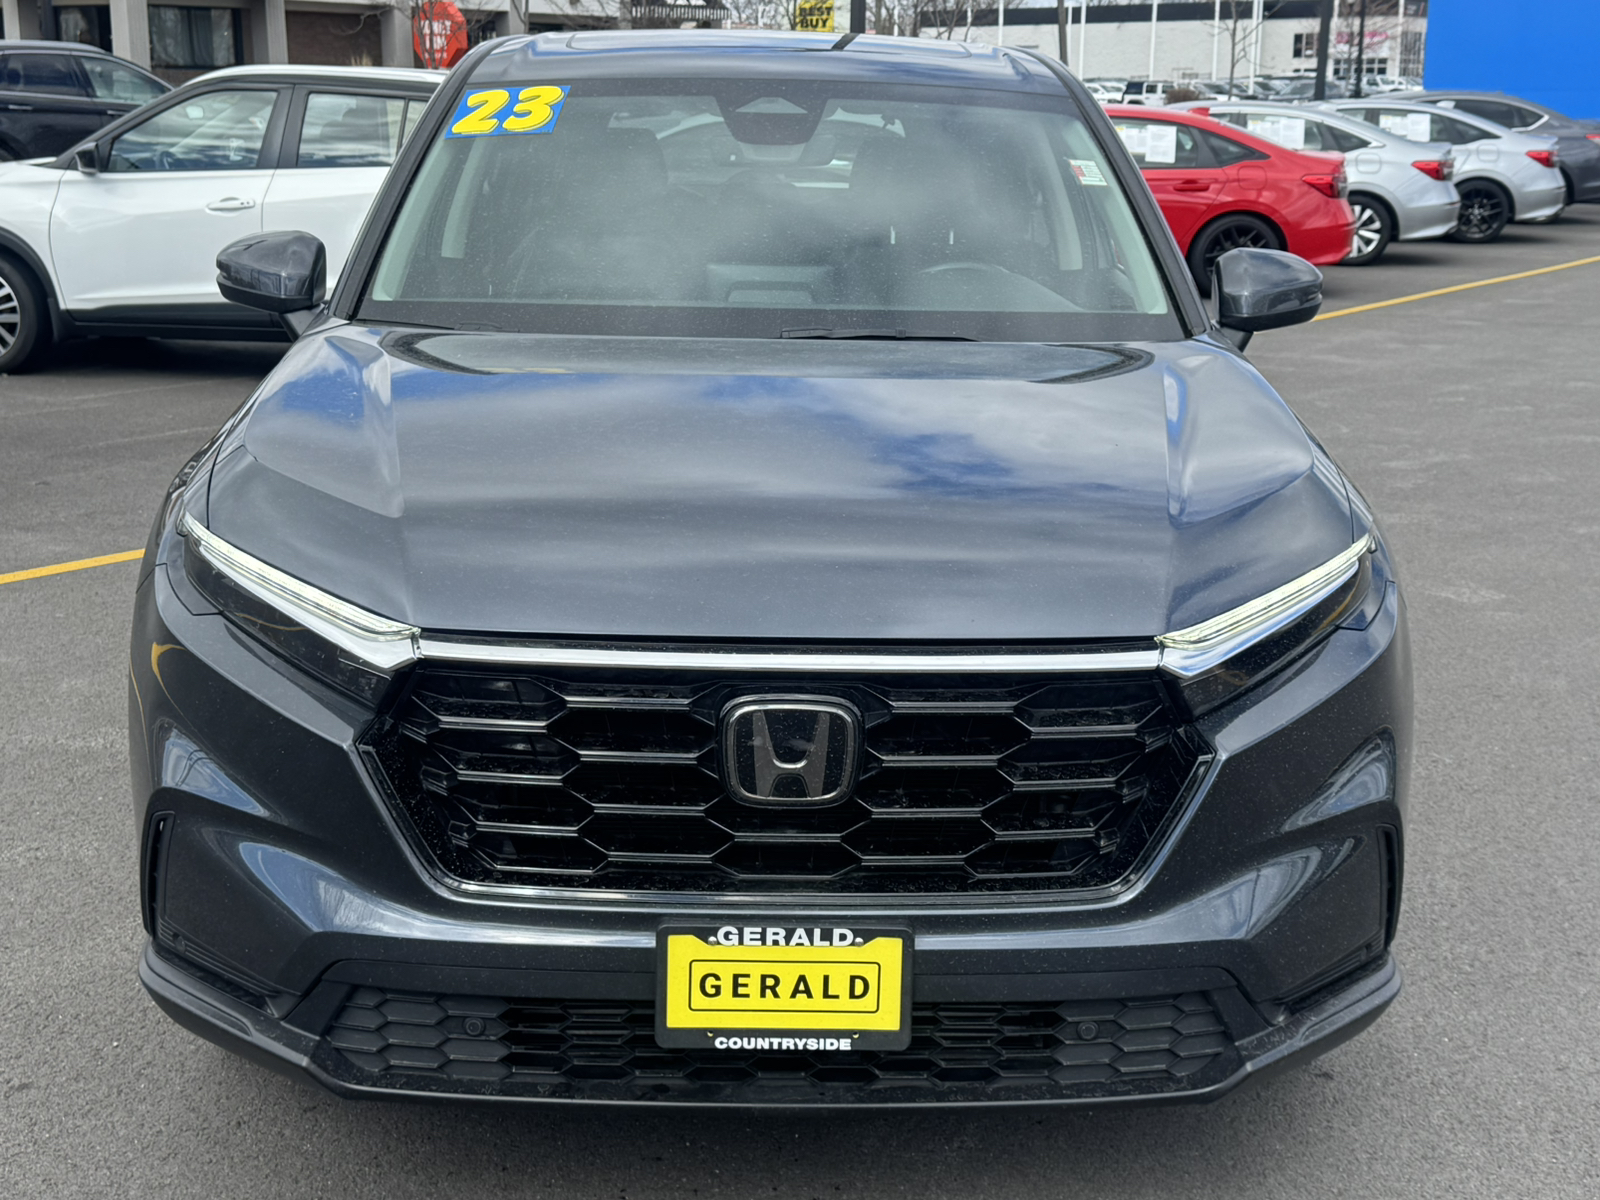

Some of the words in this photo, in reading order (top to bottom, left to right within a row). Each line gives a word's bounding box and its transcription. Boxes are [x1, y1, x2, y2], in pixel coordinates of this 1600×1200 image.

[801, 17, 830, 29] BUY
[451, 85, 564, 134] 23
[716, 925, 855, 948] GERALD
[699, 972, 870, 1000] GERALD
[714, 1036, 852, 1051] COUNTRYSIDE
